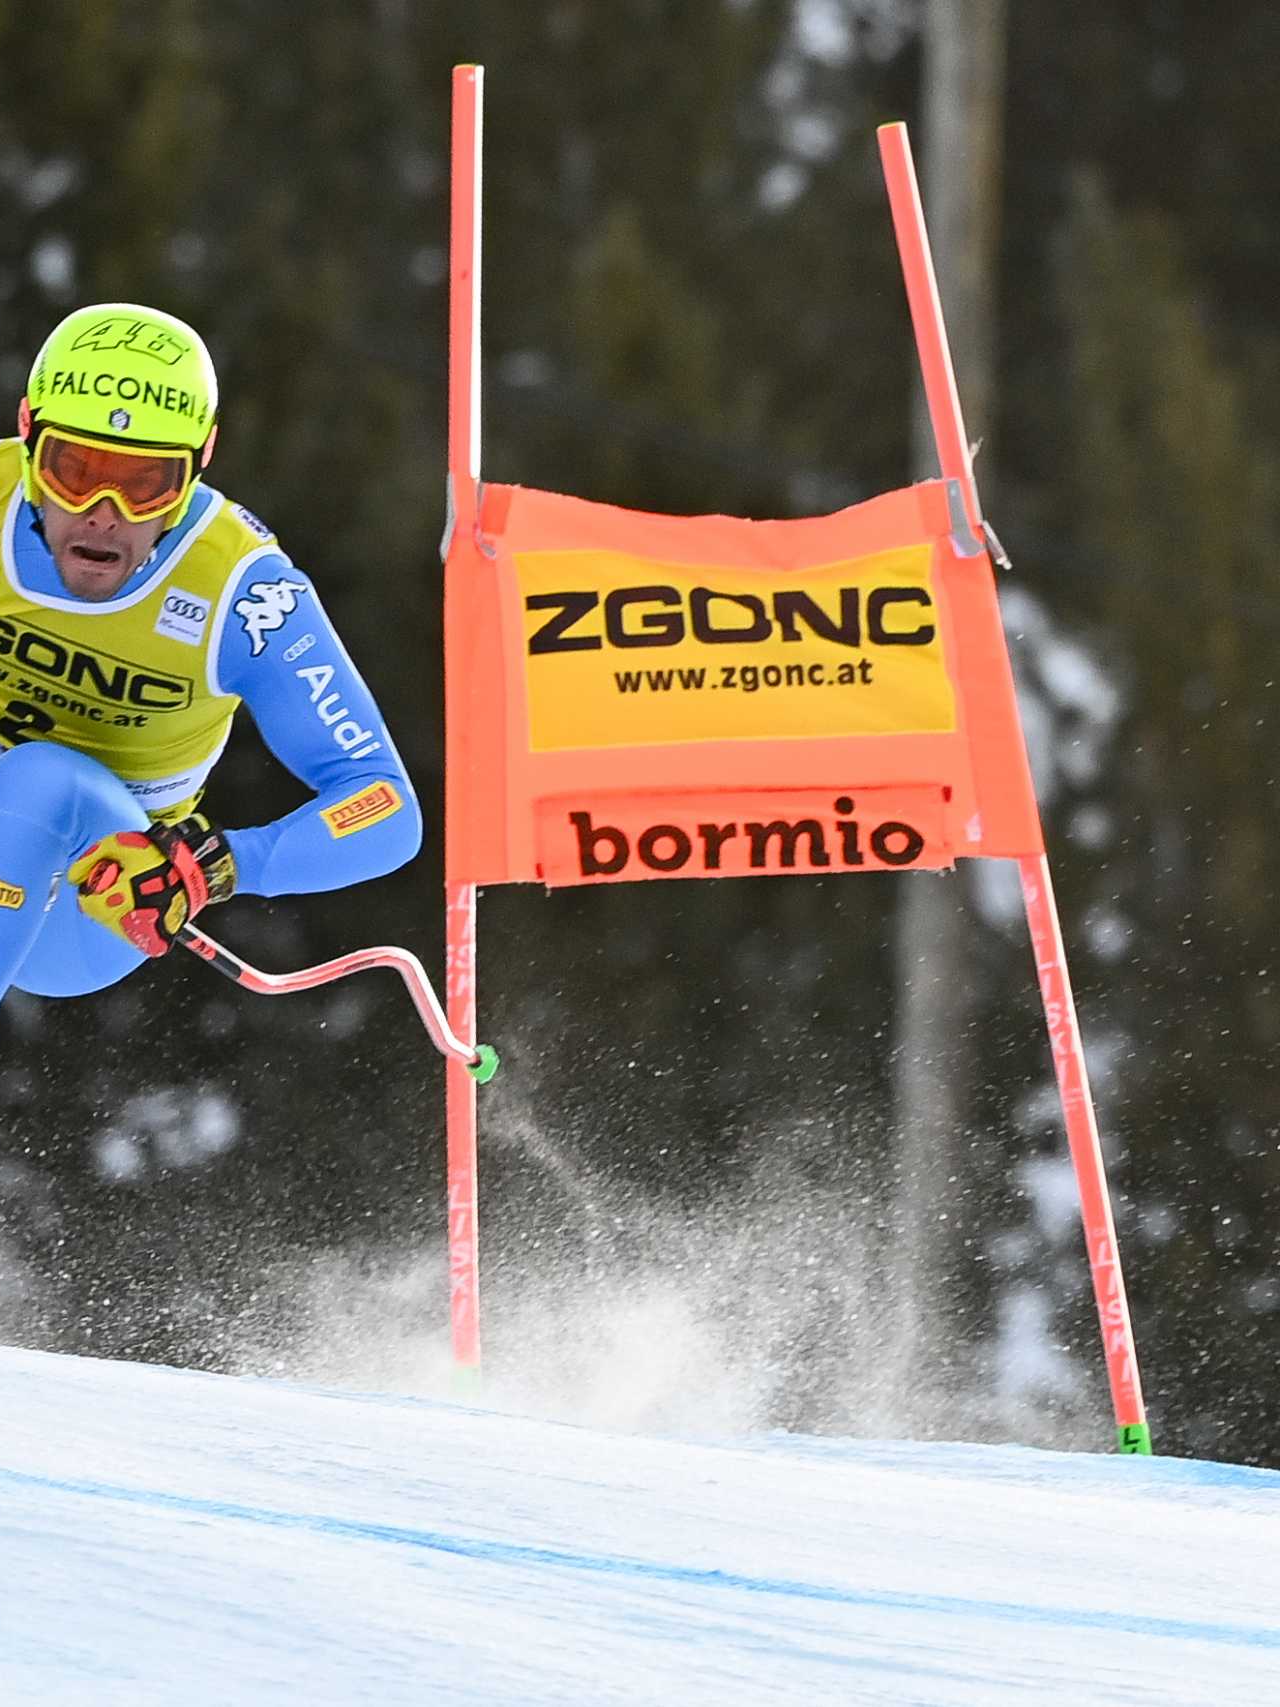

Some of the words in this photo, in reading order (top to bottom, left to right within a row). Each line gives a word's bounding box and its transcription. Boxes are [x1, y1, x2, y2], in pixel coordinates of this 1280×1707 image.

[51, 371, 196, 418] FALCONERI
[525, 584, 936, 655] ZGONC
[614, 657, 874, 693] www.zgonc.at
[295, 664, 382, 760] Audi
[569, 797, 925, 876] bormio
